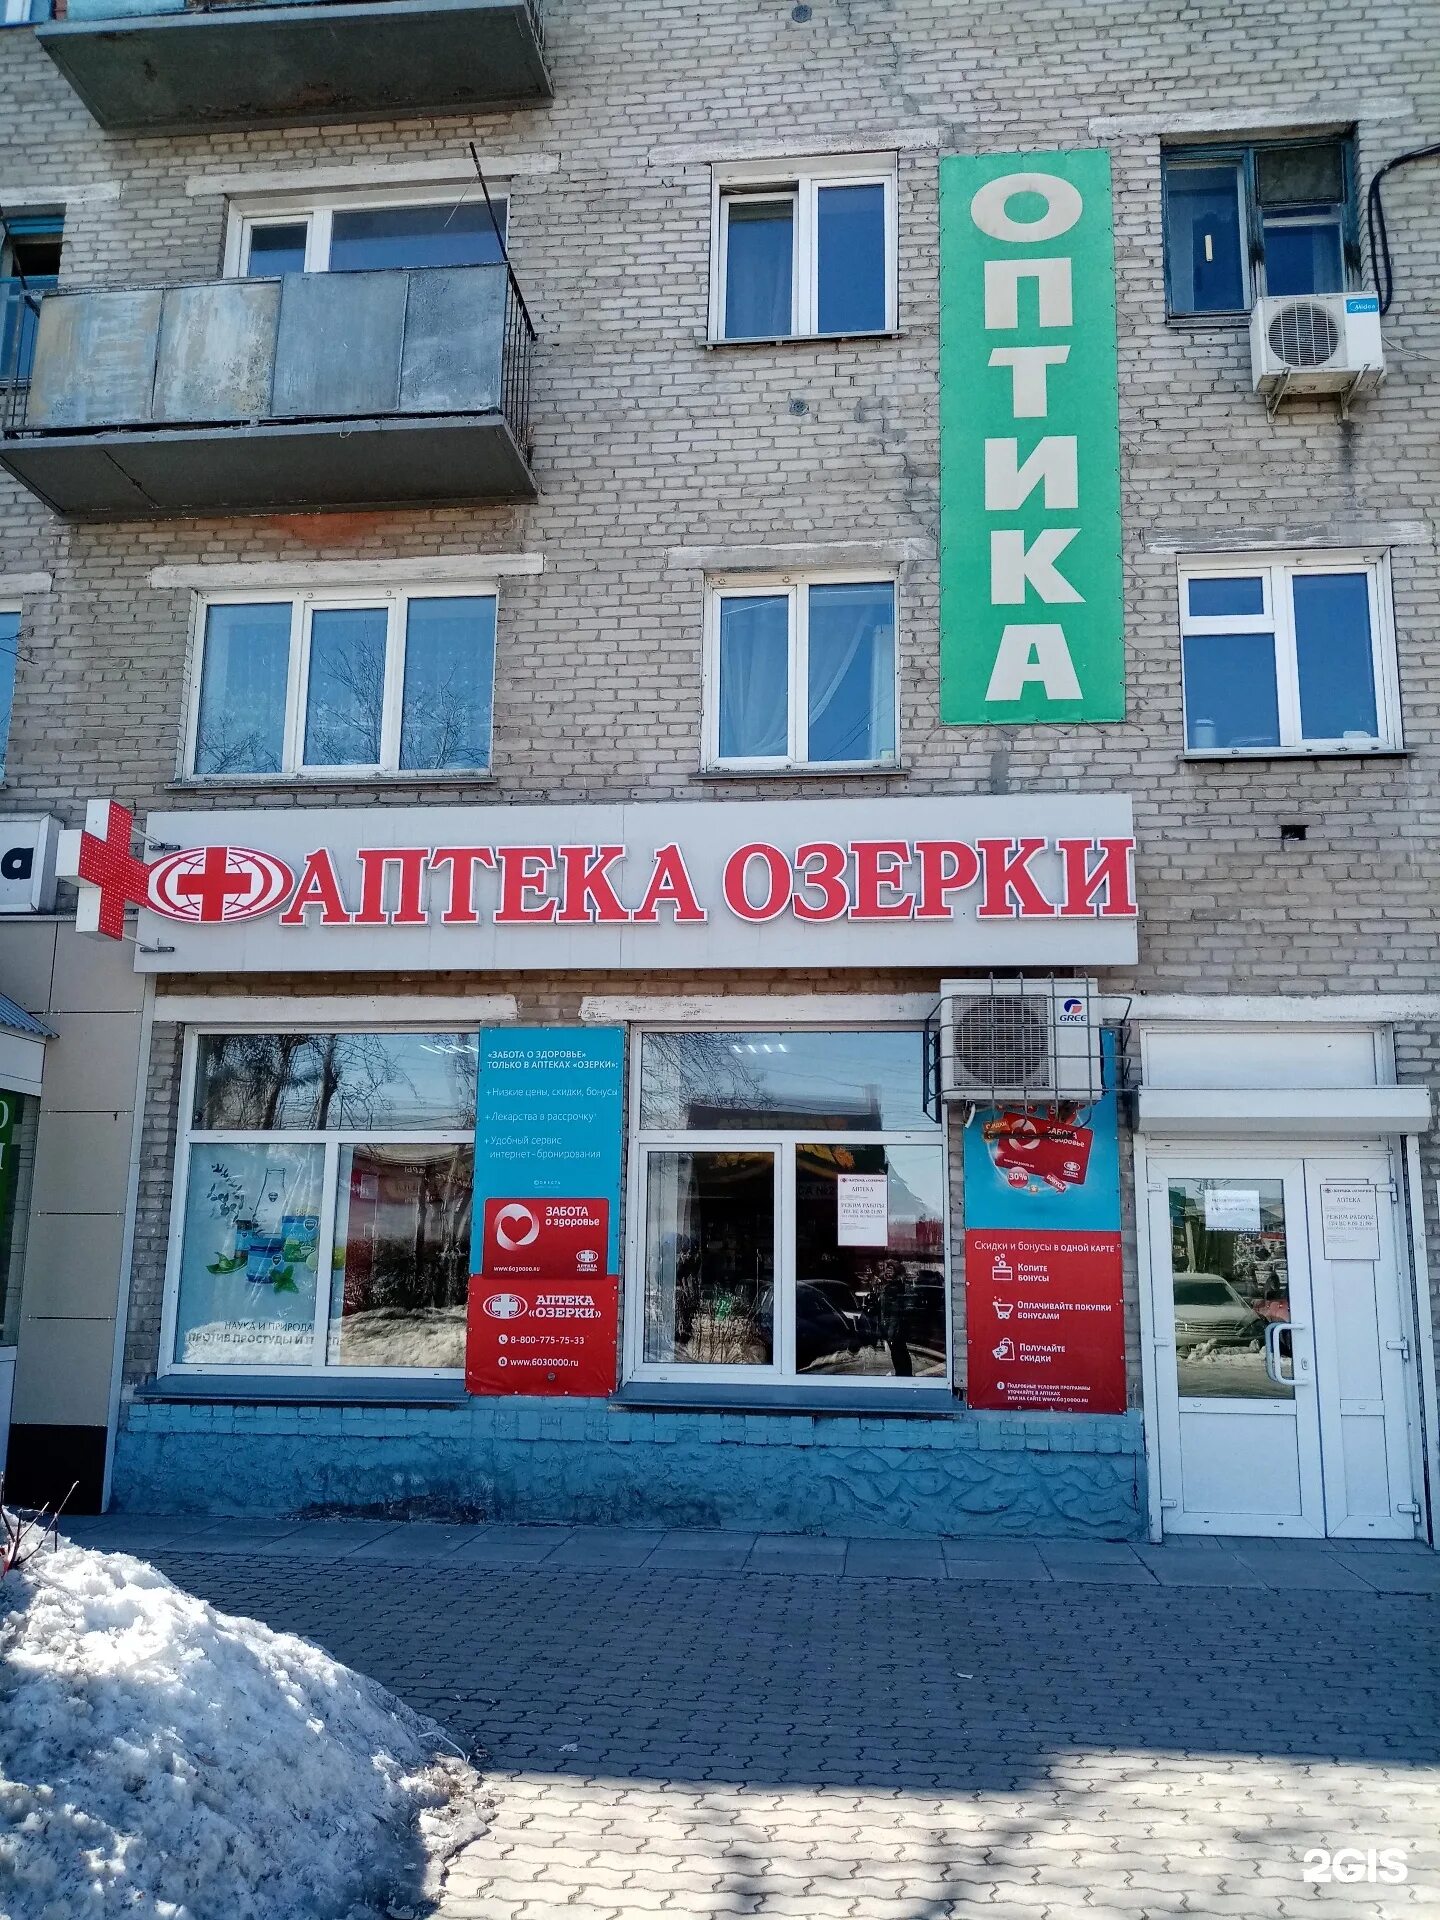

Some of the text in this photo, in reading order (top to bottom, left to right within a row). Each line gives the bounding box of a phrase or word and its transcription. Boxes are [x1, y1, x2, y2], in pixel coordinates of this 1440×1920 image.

[970, 172, 1086, 702] ОПТИКА
[279, 836, 1139, 925] АПТЕКА ОЗЕРКИ
[487, 1061, 522, 1069] ТОЛЬКО
[531, 1061, 571, 1069] АПТЕКАХ
[492, 1088, 524, 1096] Низкие
[586, 1086, 618, 1098] бонусы
[491, 1112, 538, 1123] Лекарства
[490, 1136, 562, 1147] Удобный сервис
[1008, 1172, 1028, 1181] 30%
[545, 1206, 589, 1217] ЗАБОТА
[553, 1218, 600, 1228] здоровье
[974, 1240, 1008, 1251] Скидки
[1018, 1241, 1051, 1253] бонусы
[1060, 1243, 1089, 1252] ОДНОЙ
[536, 1295, 595, 1306] АПТЕКА
[528, 1307, 602, 1319] «ОЗЕРКИ»
[224, 1321, 314, 1332] НАУКА И ПРИРОДА
[188, 1333, 231, 1343] ПРОТИВ
[232, 1334, 292, 1346] ПРОСТУДЫ
[510, 1335, 585, 1345] 8-800-775-75-33
[510, 1358, 579, 1367] www.6030000.ru
